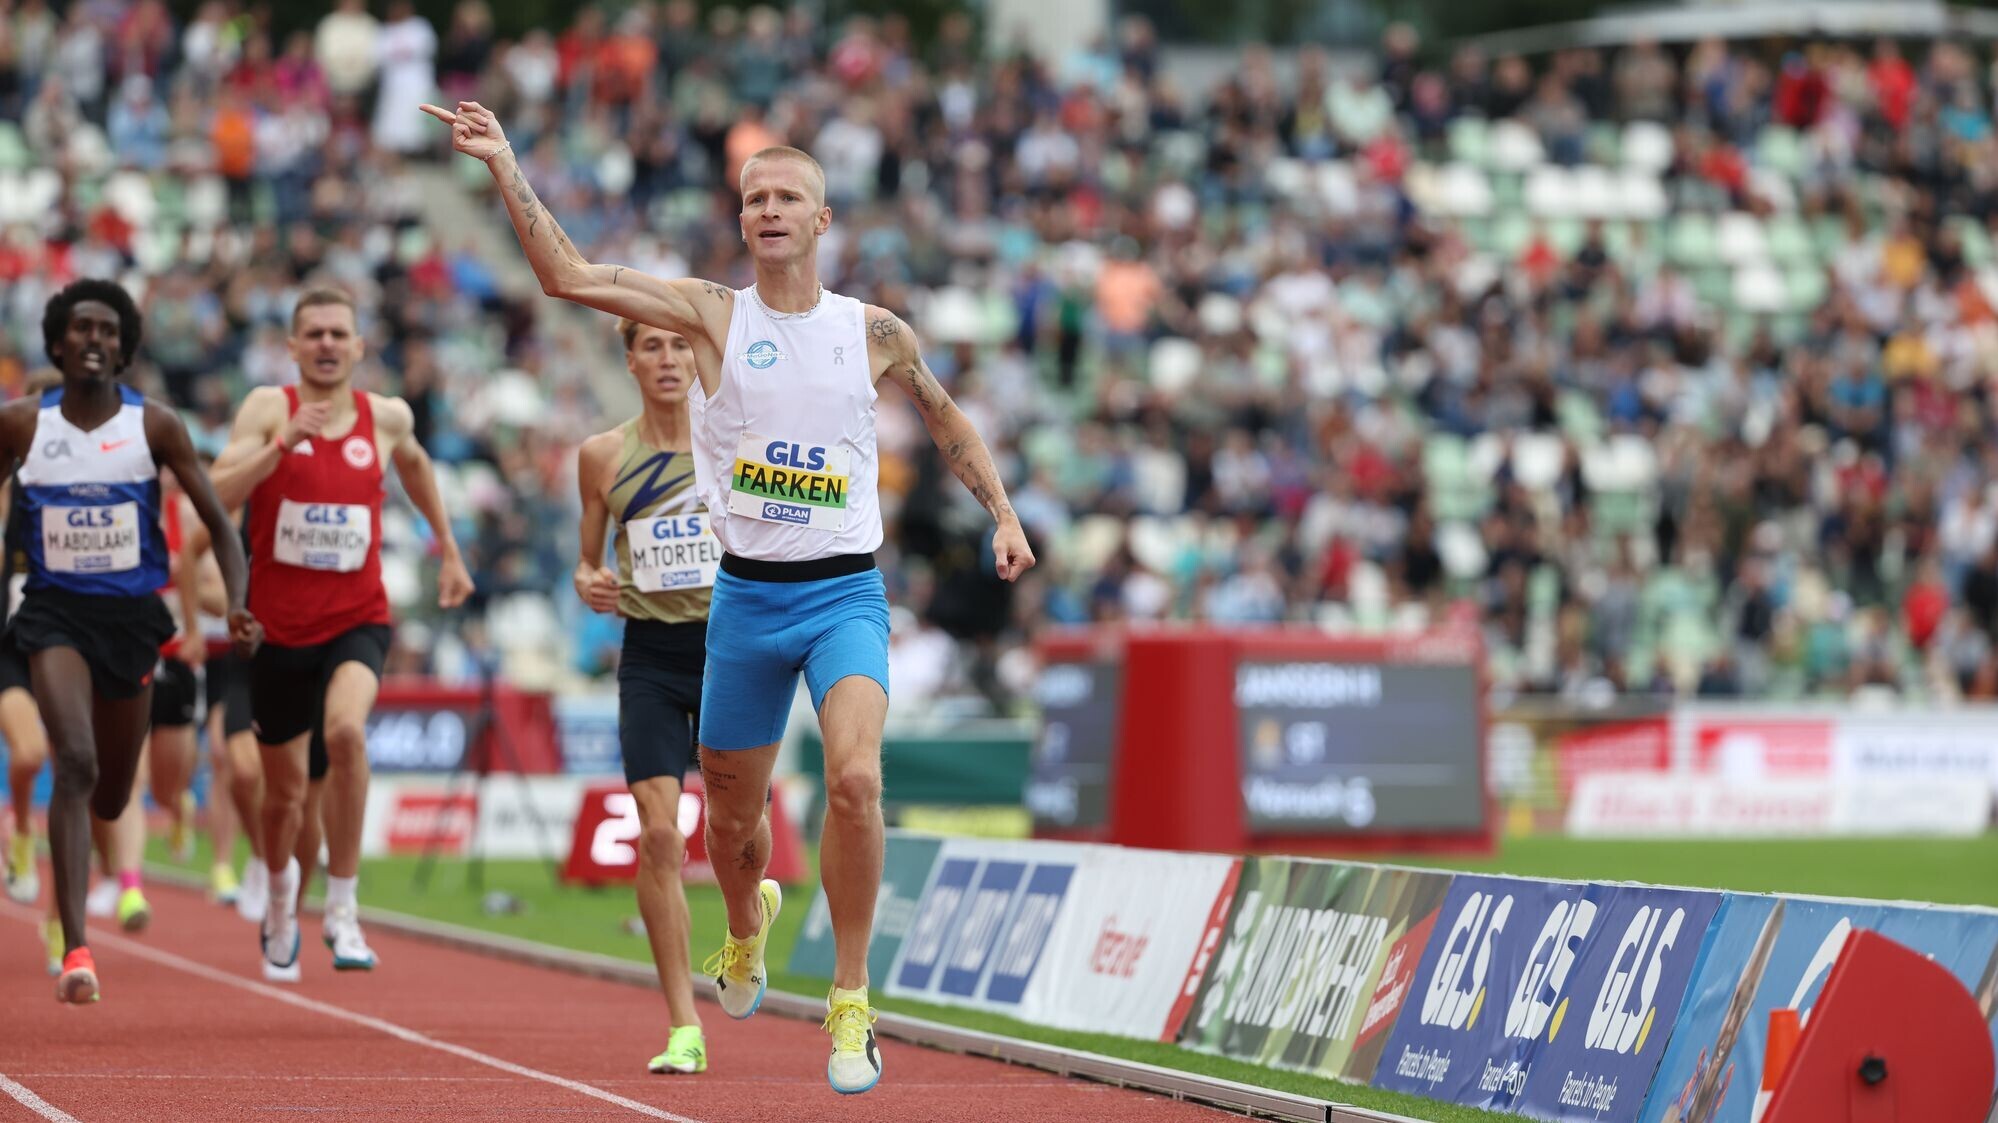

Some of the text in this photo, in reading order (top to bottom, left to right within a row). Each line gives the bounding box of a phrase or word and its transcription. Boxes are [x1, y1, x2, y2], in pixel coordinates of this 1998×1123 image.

[739, 462, 842, 504] FARKEN
[782, 507, 809, 519] PLAN
[1223, 904, 1388, 1041] BUNDESWEHR
[1395, 1044, 1451, 1092] Parcels to People
[1478, 1058, 1508, 1092] Parcel
[1558, 1070, 1618, 1120] Parcels to People
